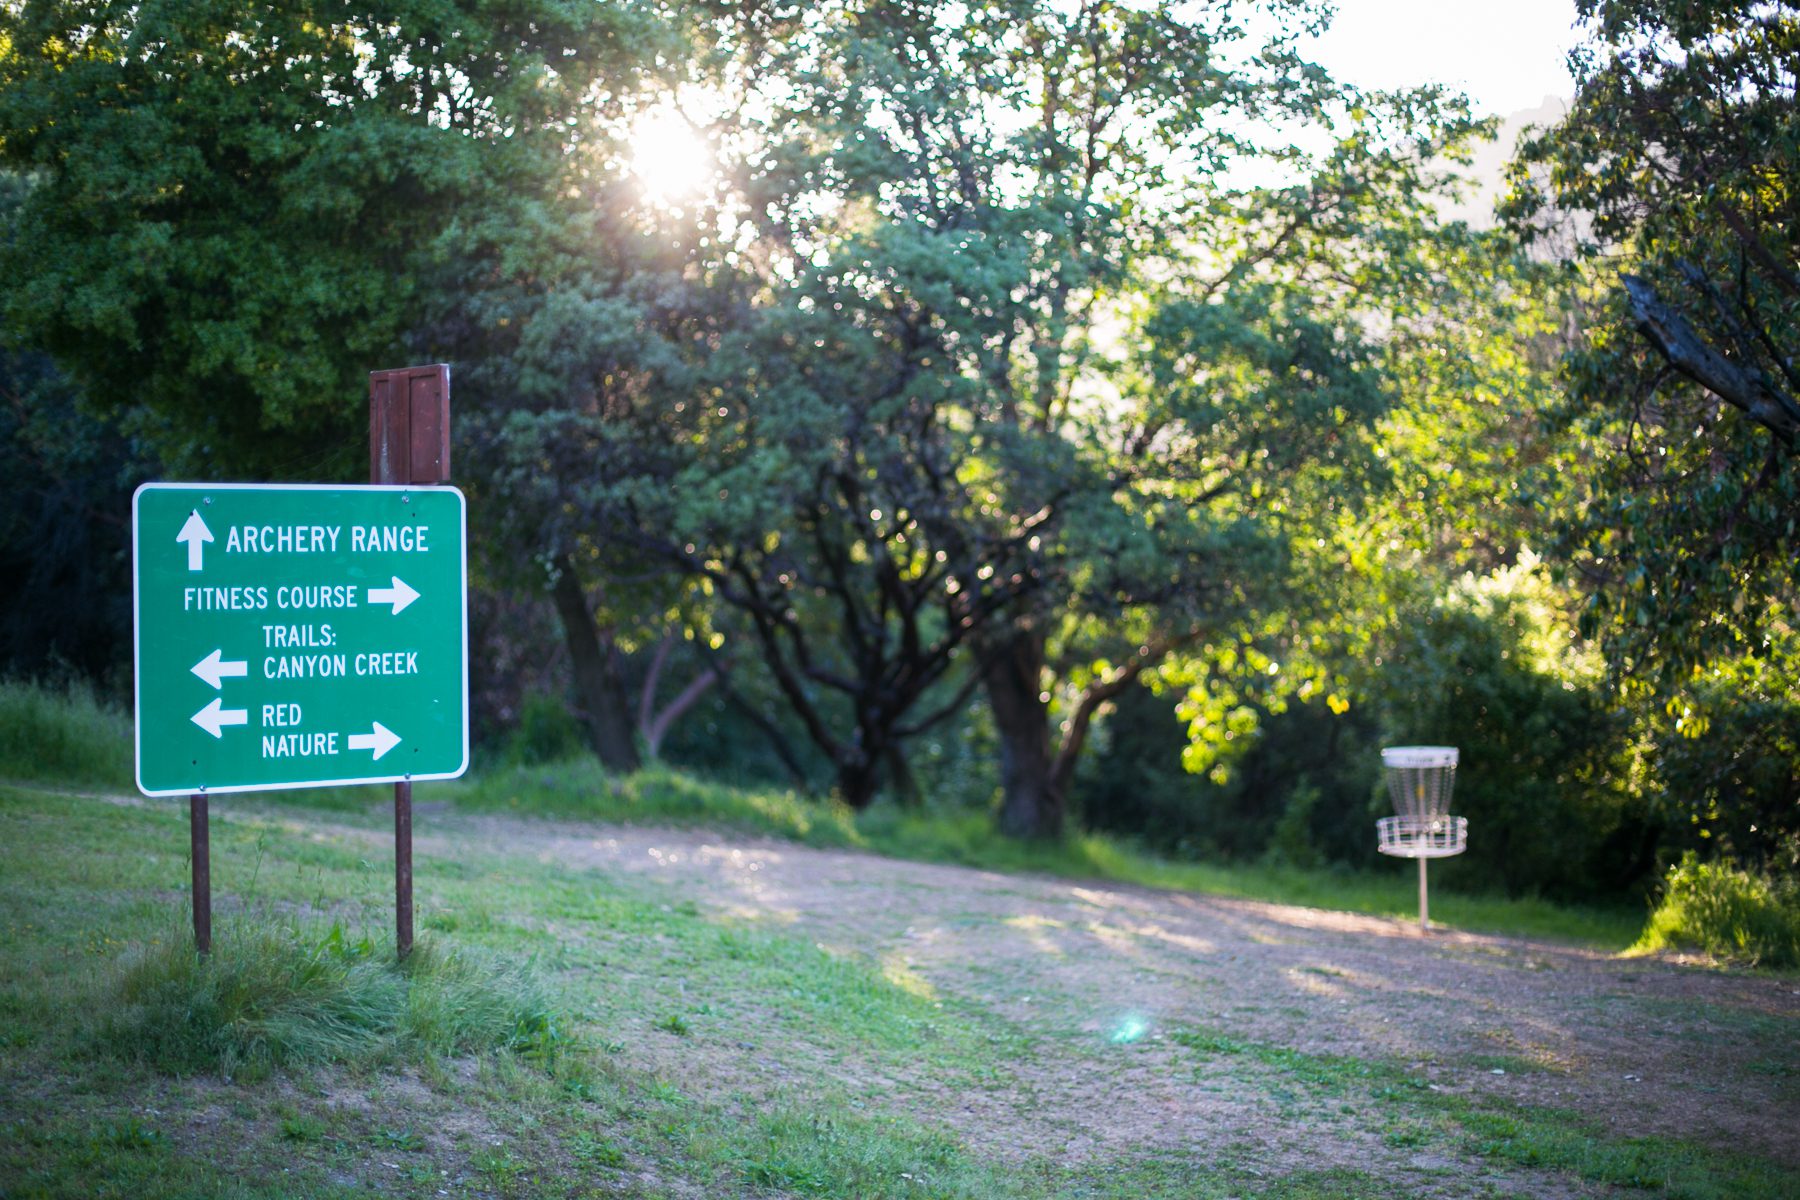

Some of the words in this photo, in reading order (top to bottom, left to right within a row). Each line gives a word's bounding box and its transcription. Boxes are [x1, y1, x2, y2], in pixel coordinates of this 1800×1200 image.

[226, 526, 341, 553] ARCHERY
[352, 526, 429, 552] RANGE
[184, 587, 268, 610] FITNESS
[277, 585, 358, 609] COURSE
[263, 624, 337, 648] TRAILS:
[264, 654, 346, 679] CANYON
[355, 652, 418, 675] CREEK
[262, 703, 302, 727] RED
[262, 732, 339, 758] NATURE
